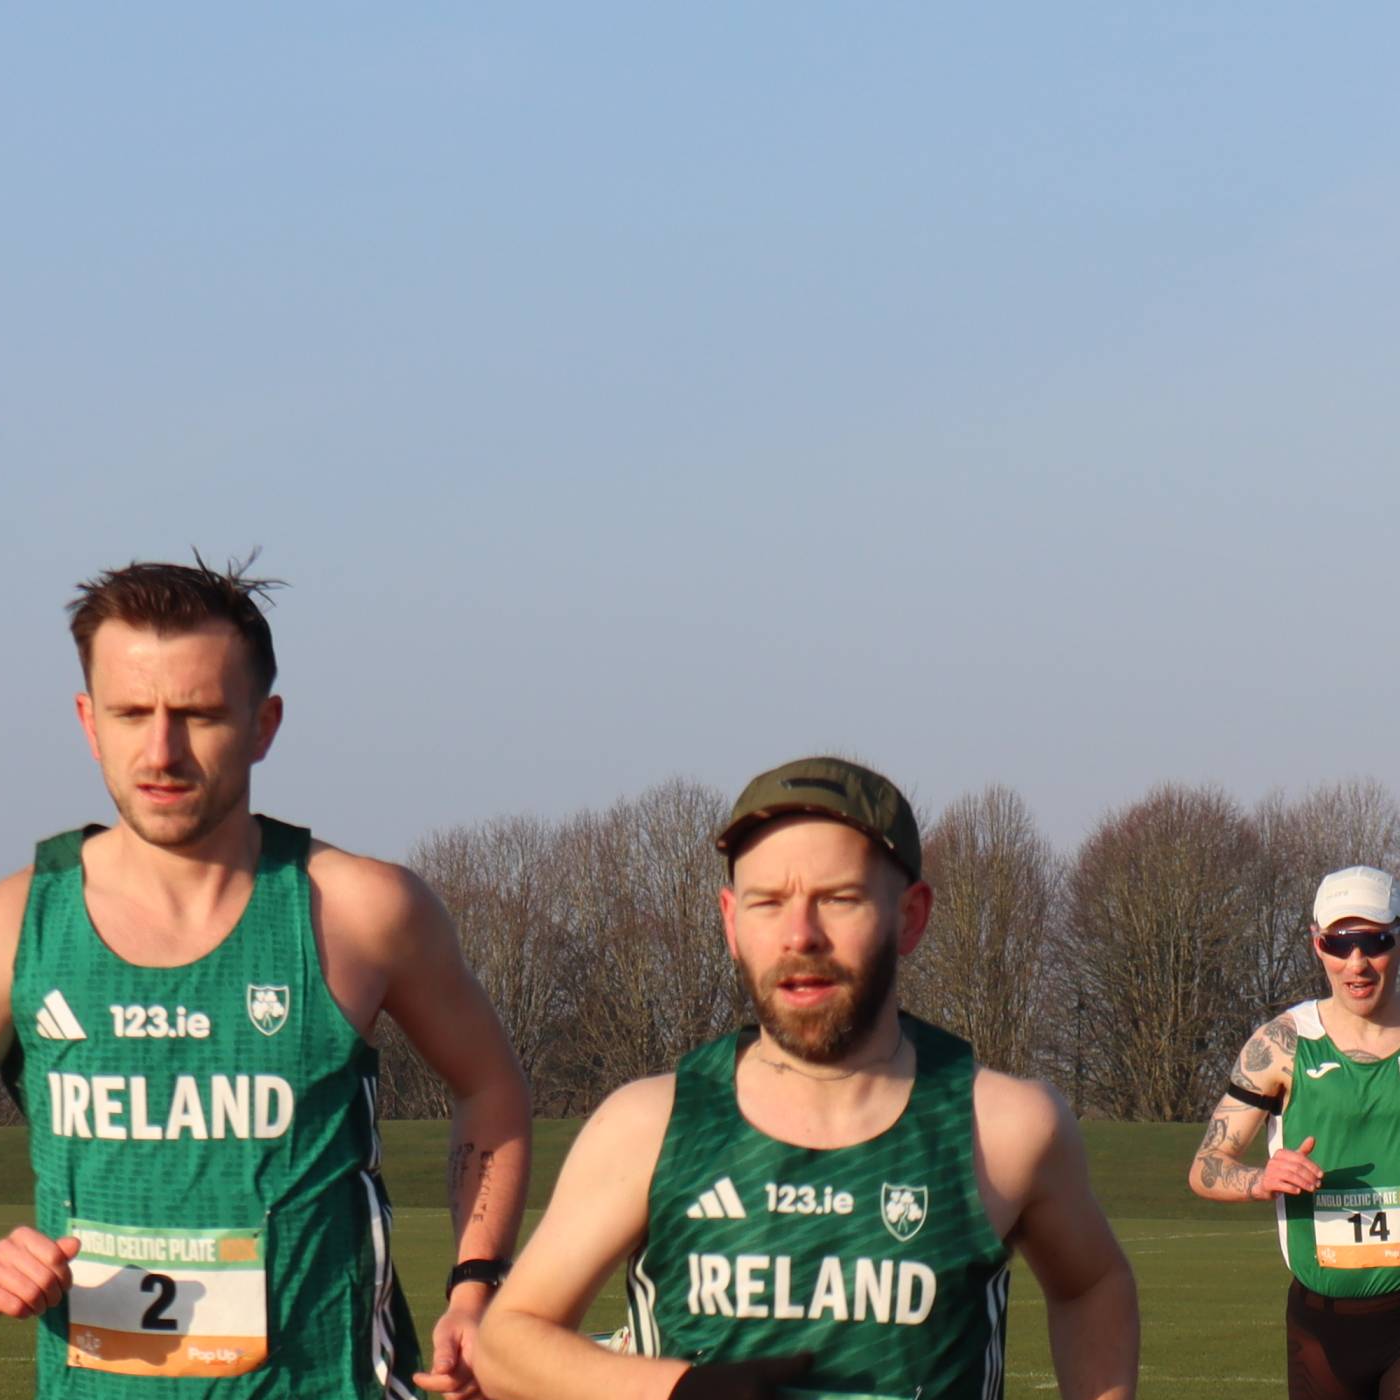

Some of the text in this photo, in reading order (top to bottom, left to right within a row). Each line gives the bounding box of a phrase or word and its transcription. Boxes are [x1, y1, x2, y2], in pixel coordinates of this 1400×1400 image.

[109, 1005, 211, 1039] 123.ie
[48, 1073, 295, 1140] IRELAND
[765, 1183, 854, 1215] 123.ie
[1316, 1194, 1342, 1207] ANGLO
[1343, 1194, 1371, 1206] CELTIC
[1373, 1191, 1398, 1205] PLATE
[1348, 1211, 1390, 1243] 14
[117, 1235, 167, 1261] CELTIC
[168, 1238, 216, 1262] PLATE
[140, 1273, 178, 1330] 2
[687, 1253, 937, 1325] IRELAND
[188, 1347, 238, 1363] Pop Up
